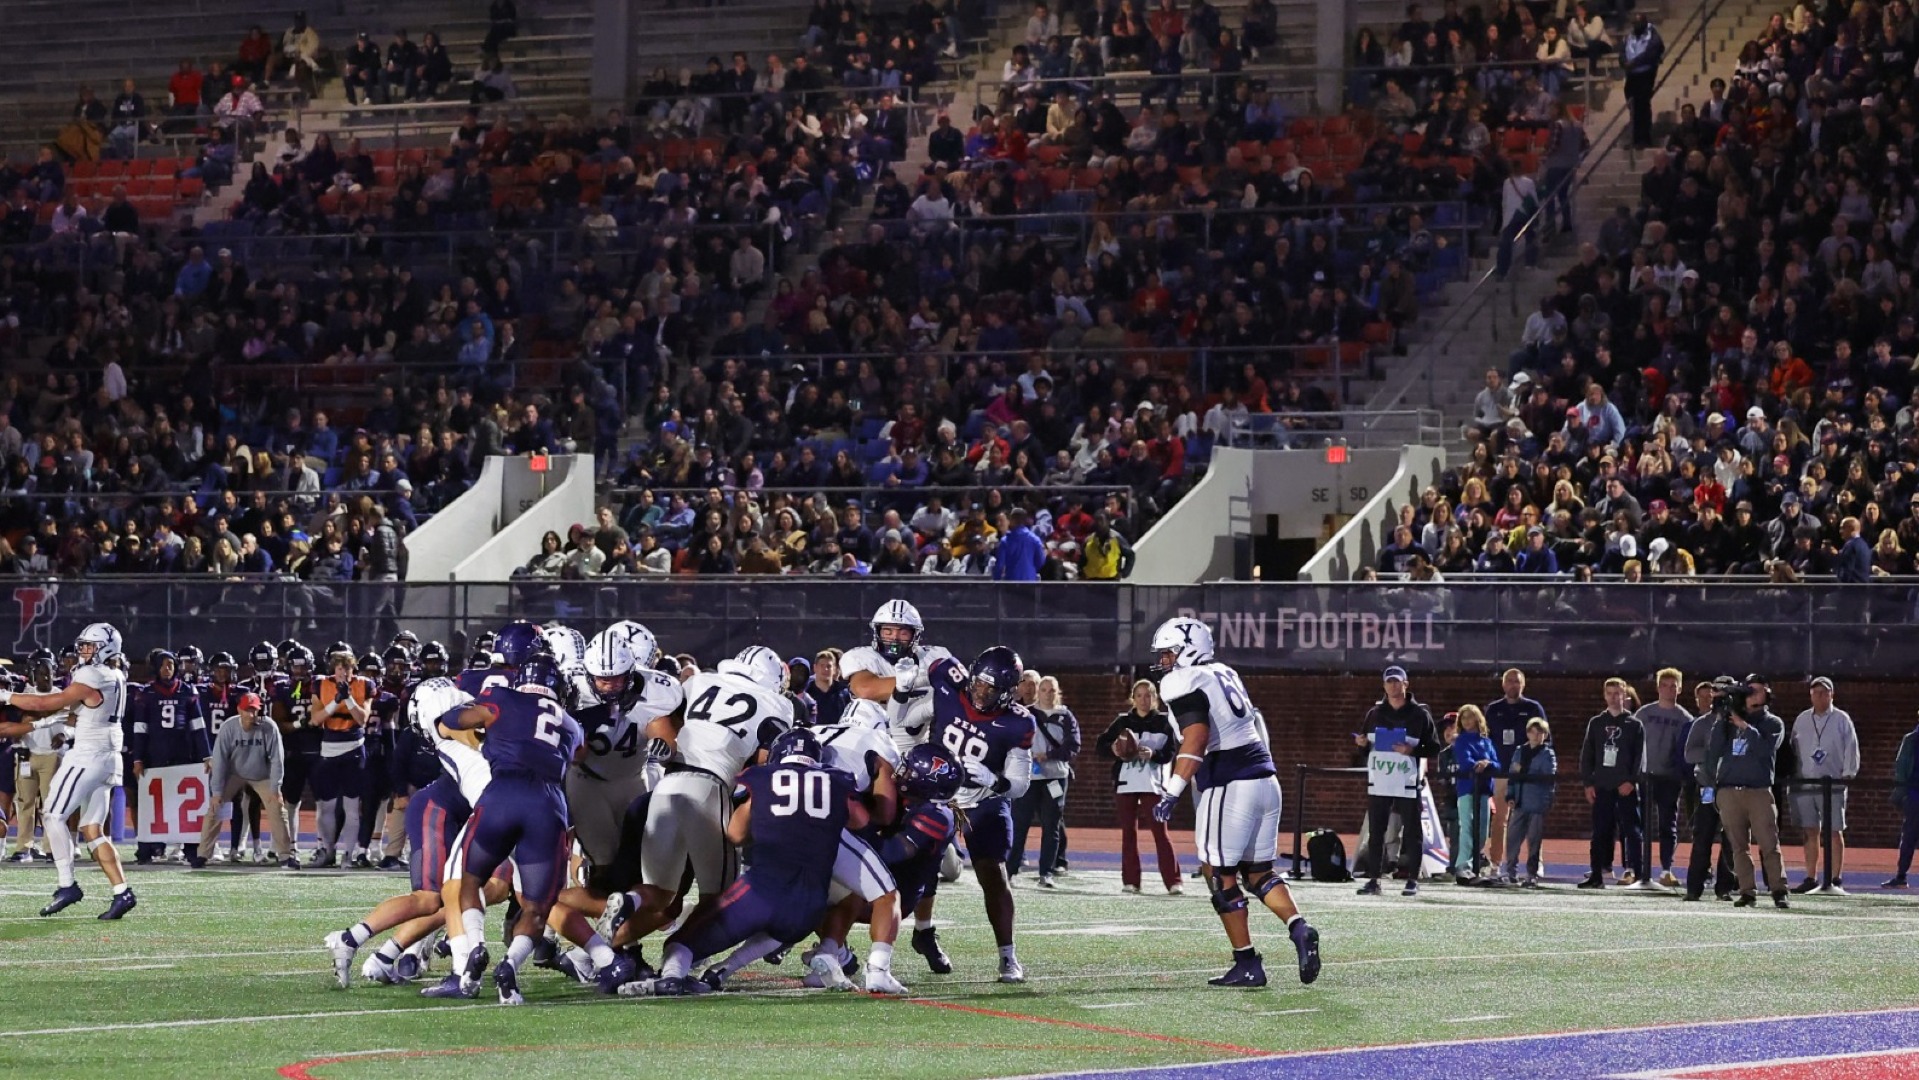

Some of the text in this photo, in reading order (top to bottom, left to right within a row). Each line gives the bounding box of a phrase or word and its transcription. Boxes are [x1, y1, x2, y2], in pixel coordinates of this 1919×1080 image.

[1311, 487, 1368, 502] SE SD
[1175, 623, 1201, 645] Y
[161, 705, 175, 728] 9
[534, 698, 562, 748] 2
[687, 685, 758, 739] 42
[954, 717, 986, 738] PENN
[1372, 756, 1396, 775] Ivy
[149, 777, 204, 834] 12
[770, 769, 831, 819] 90
